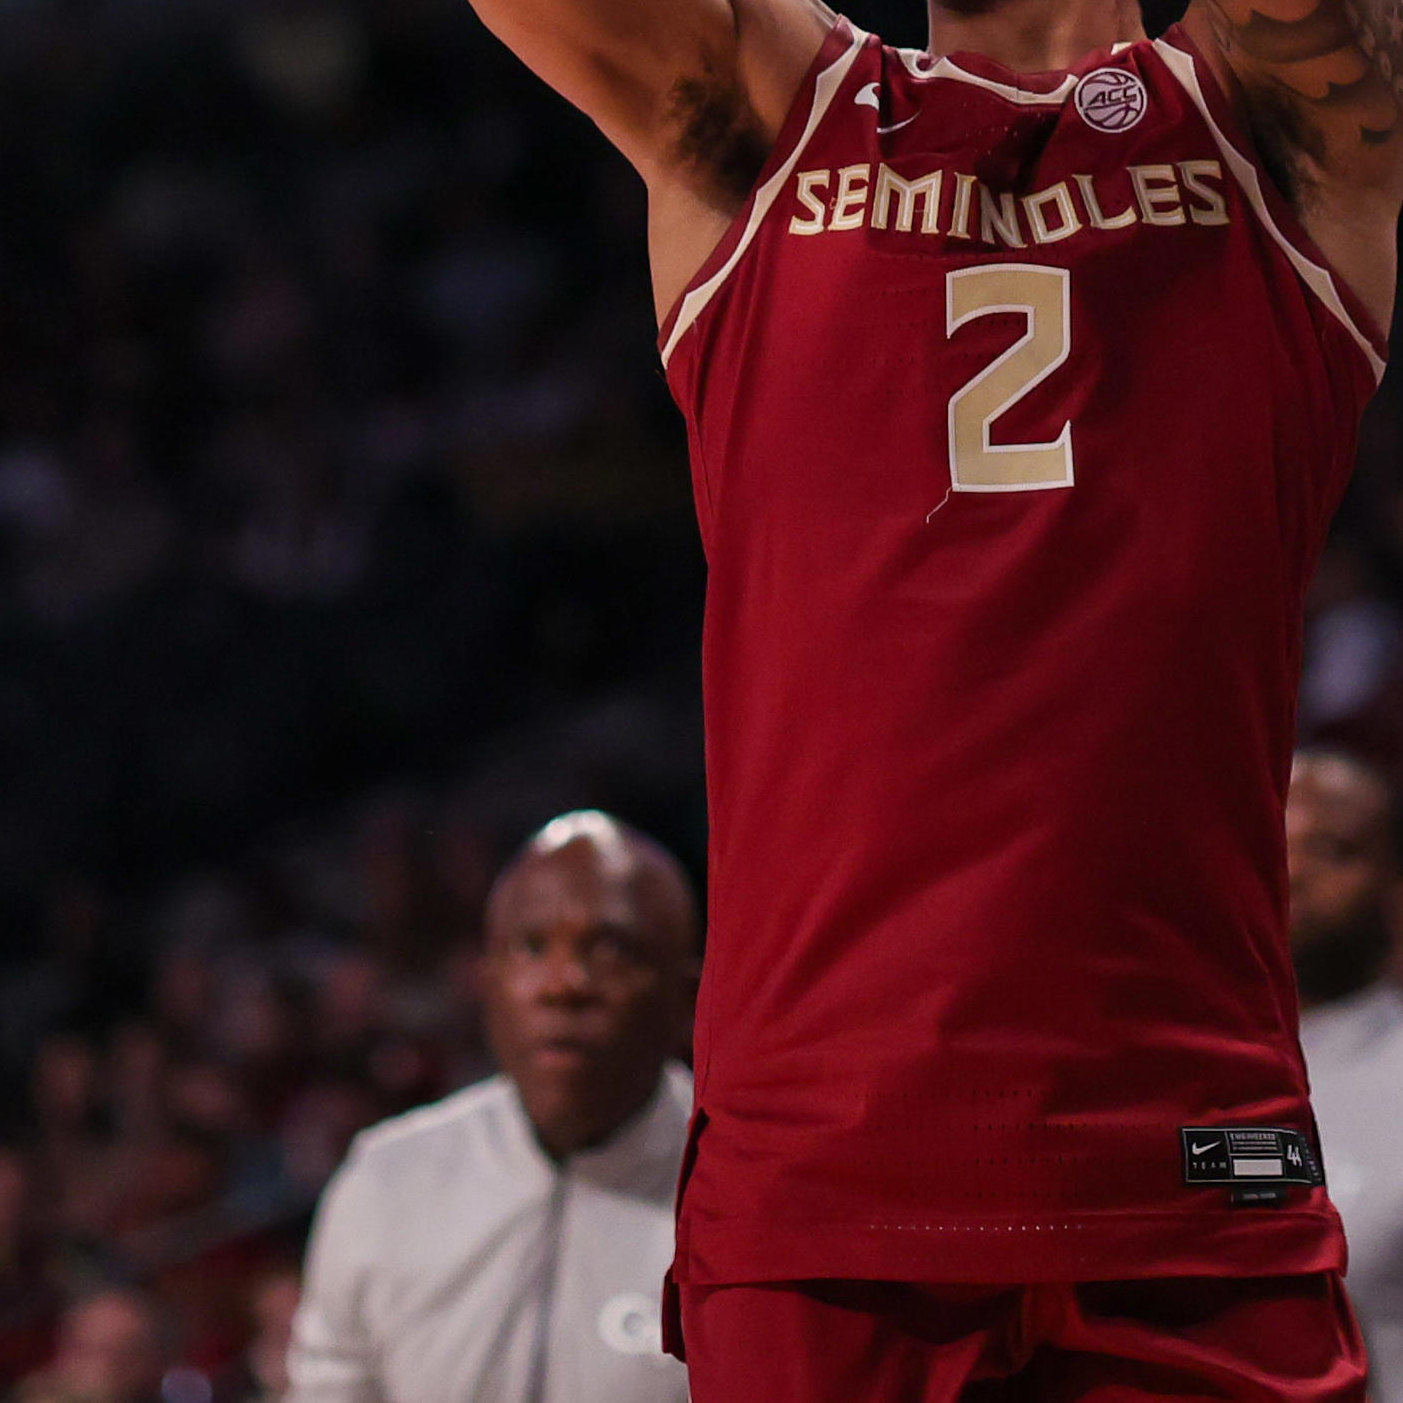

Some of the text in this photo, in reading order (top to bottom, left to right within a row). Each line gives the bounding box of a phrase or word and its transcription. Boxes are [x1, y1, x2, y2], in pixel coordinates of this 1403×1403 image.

[1087, 84, 1137, 105] ACC
[788, 160, 1229, 248] SEMINOLES
[946, 263, 1074, 492] 2
